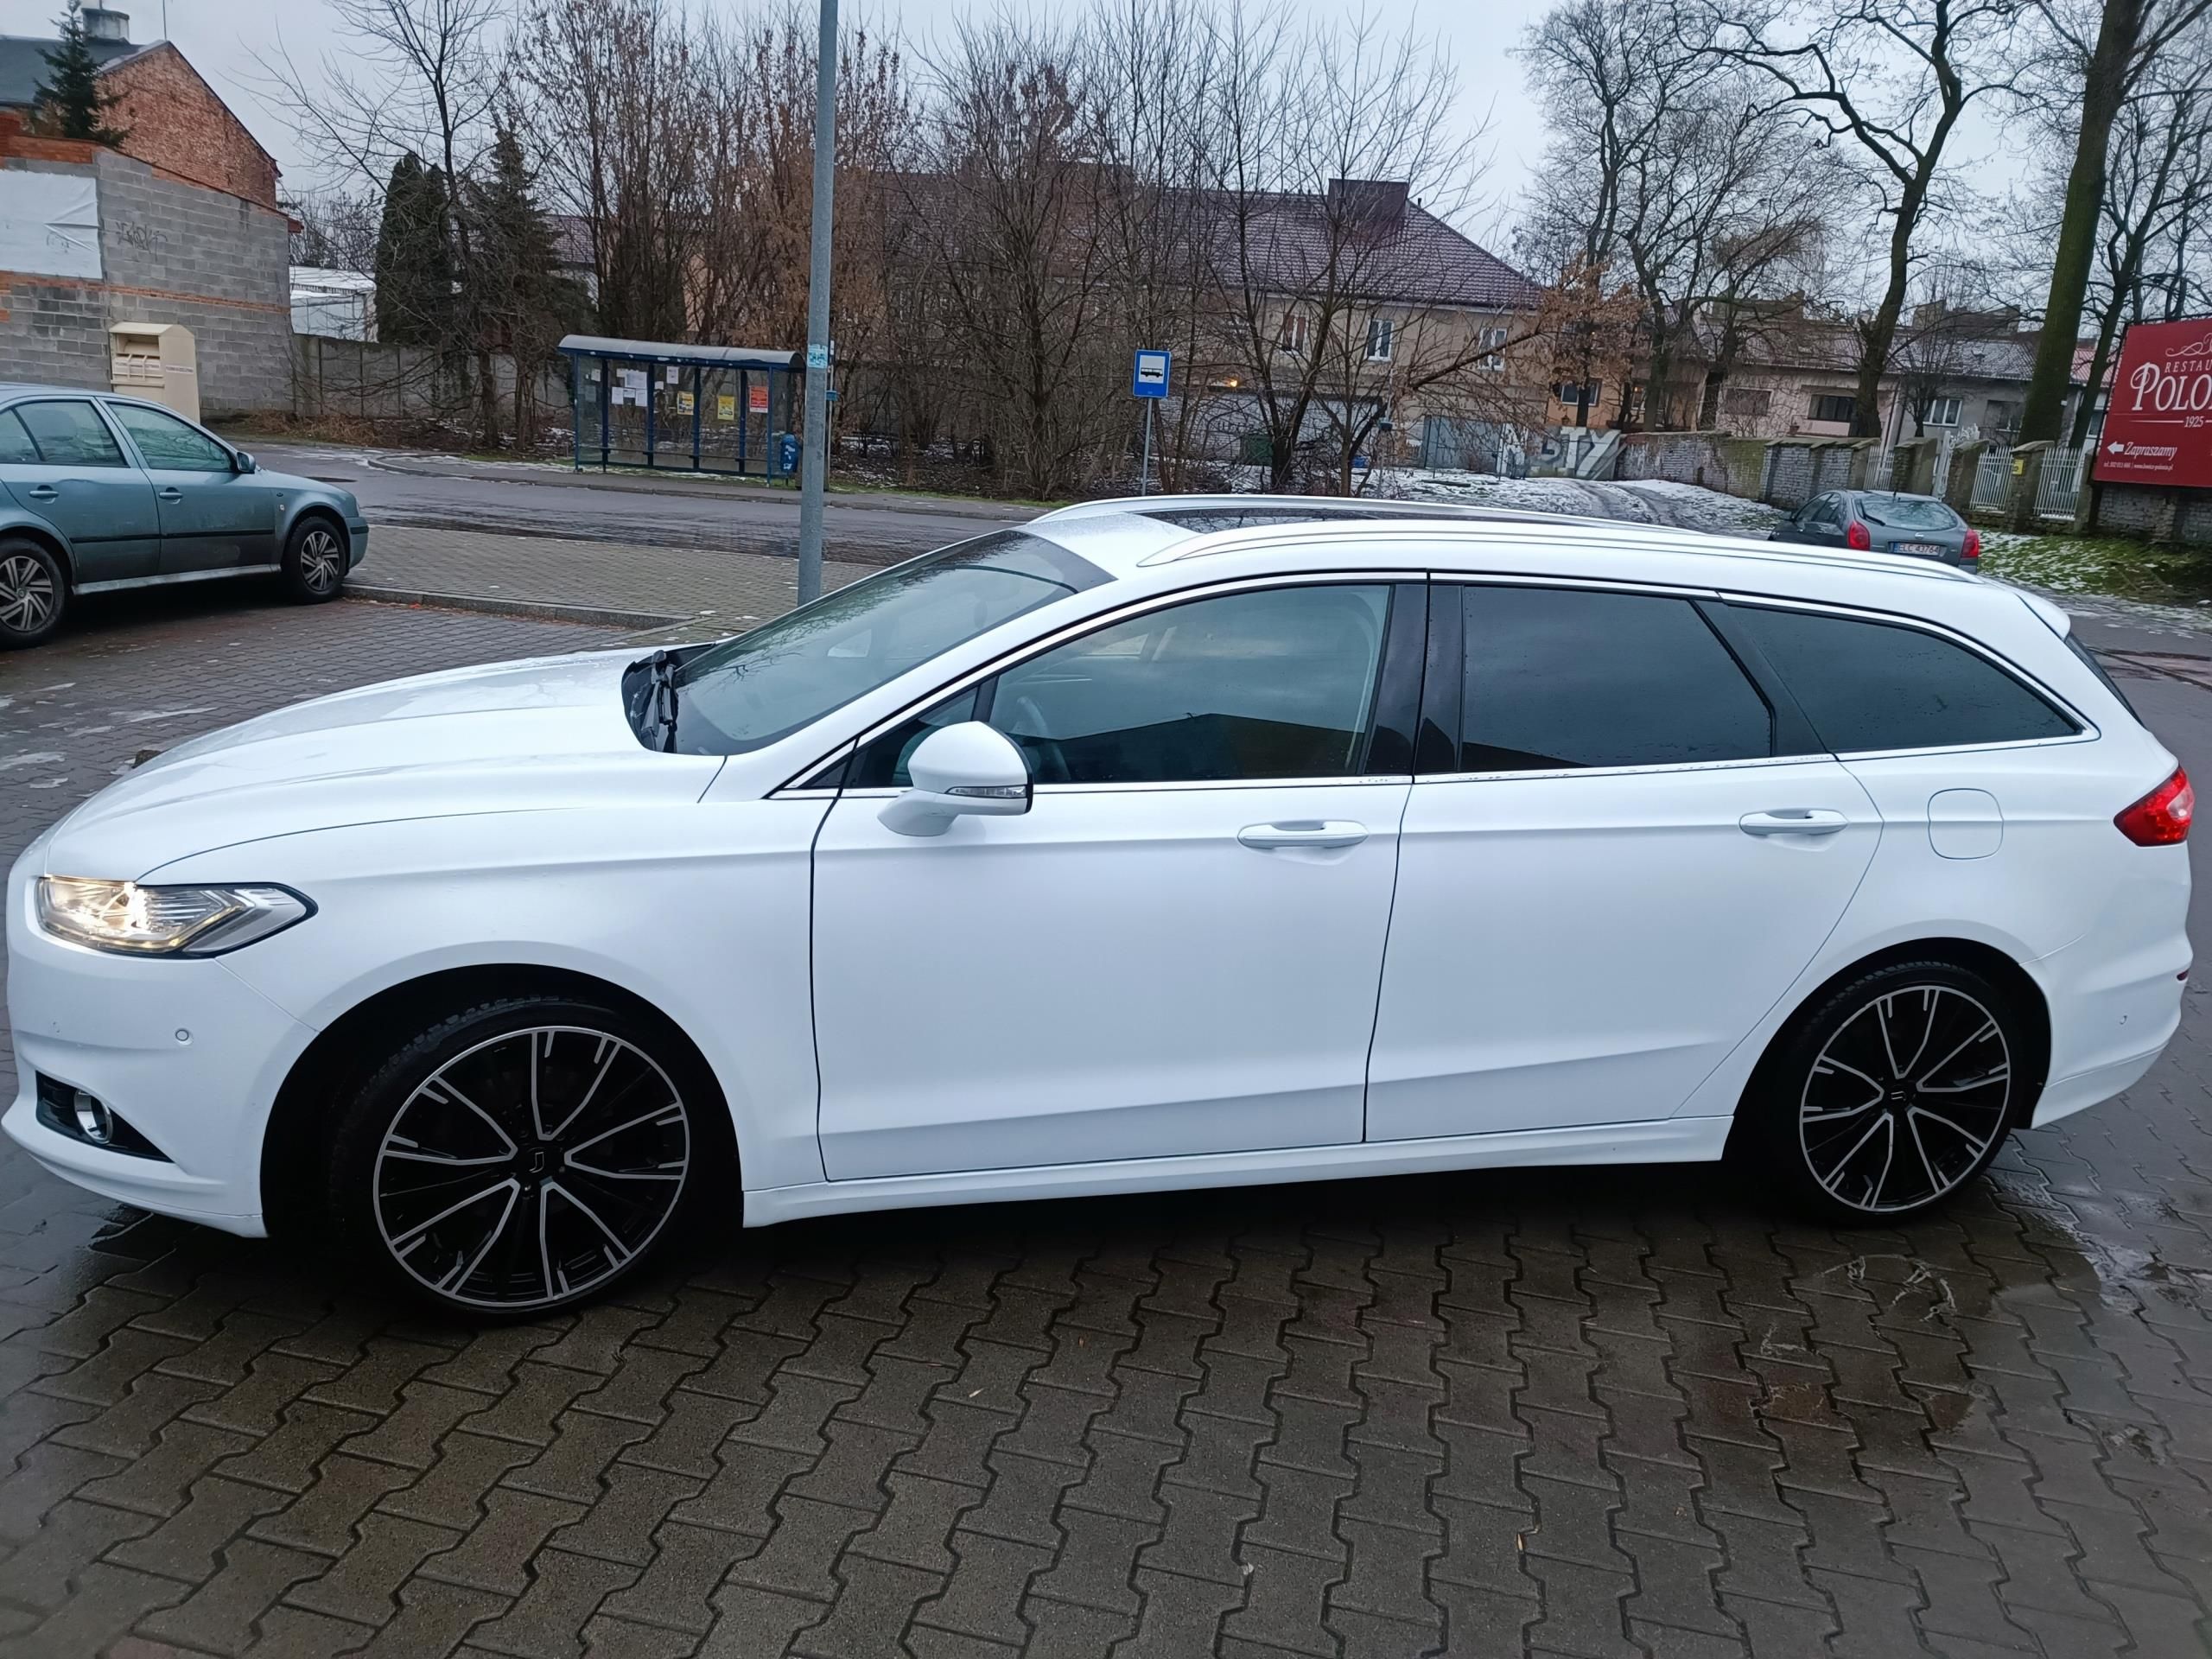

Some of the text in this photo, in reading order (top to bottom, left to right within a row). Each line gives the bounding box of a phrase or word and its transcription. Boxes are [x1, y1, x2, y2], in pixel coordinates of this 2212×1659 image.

[2130, 362, 2212, 411] POLO
[2184, 416, 2204, 428] 1925
[2124, 442, 2177, 461] Zapraszamy
